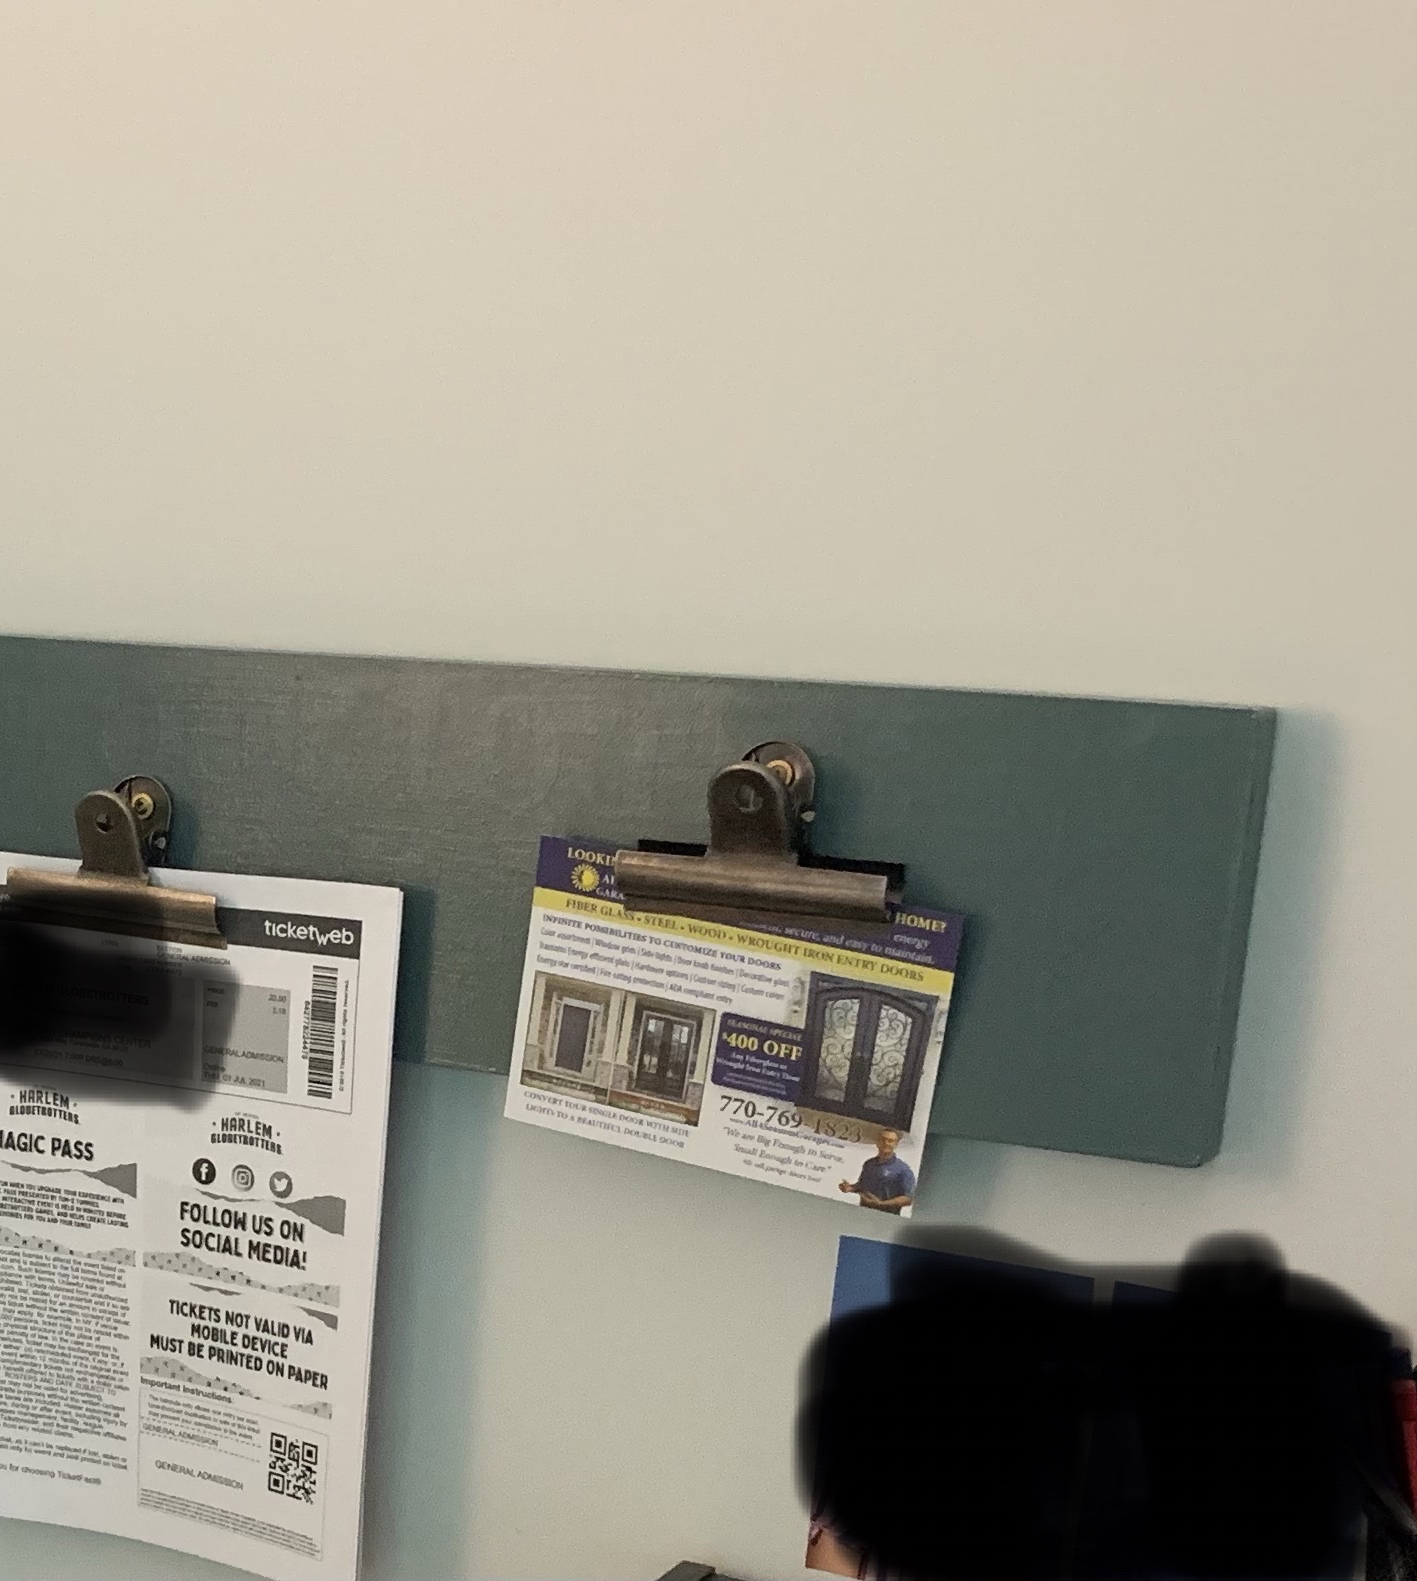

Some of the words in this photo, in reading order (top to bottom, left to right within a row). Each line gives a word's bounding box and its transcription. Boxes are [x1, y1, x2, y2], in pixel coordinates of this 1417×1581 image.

[264, 920, 354, 946] ticketweb
[895, 912, 948, 933] HOME?
[543, 914, 582, 928] INFINITE
[585, 922, 647, 942] POSSIBILITIES
[649, 936, 661, 945] TO
[663, 939, 717, 958] CUSTOMIZE
[720, 951, 745, 963] YOUR
[747, 957, 781, 970] DOORS
[643, 916, 678, 930] STEEL
[688, 924, 726, 939] WOOD
[737, 933, 800, 955] WROUGHT
[803, 947, 835, 964] IRON
[837, 954, 878, 971] ENTRY
[880, 964, 924, 982] DOORS
[893, 932, 931, 949] energy
[192, 954, 230, 965] ADMISSION
[241, 1049, 285, 1064] ADMISSION
[722, 1032, 758, 1051] $400
[763, 1040, 803, 1060] OFF
[249, 1076, 266, 1087] 2021
[20, 1090, 69, 1109] HARLEM
[524, 1091, 562, 1106] CONVERT
[588, 1106, 617, 1119] SINGLE
[619, 1113, 644, 1126] DOOR
[646, 1120, 669, 1133] WITH
[221, 1117, 272, 1139] HARLEM
[557, 1110, 568, 1119] TO
[577, 1116, 621, 1133] BEAUTIFUL
[720, 1095, 862, 1142] 770-769-1823
[51, 1137, 94, 1161] PASS
[180, 1201, 247, 1231] FOLLOW
[252, 1214, 274, 1236] US
[280, 1220, 305, 1242] ON
[180, 1228, 243, 1258] SOCIAL
[248, 1240, 307, 1271] MEDIA!
[169, 1299, 221, 1323] TICKETS
[225, 1311, 251, 1328] NOT
[254, 1316, 290, 1338] VALID
[293, 1326, 313, 1345] VIA
[191, 1322, 238, 1346] MOBILE
[242, 1334, 288, 1359] DEVICE
[150, 1334, 184, 1354] MUST
[188, 1341, 204, 1358] BE
[208, 1346, 263, 1371] PRINTED
[266, 1360, 284, 1377] ON
[288, 1365, 328, 1390] PAPER
[140, 1376, 181, 1392] Important
[143, 1423, 176, 1436] GENERAL
[178, 1431, 218, 1447] ADMISSION
[155, 1459, 195, 1477] GENERAL
[197, 1470, 244, 1491] ADMISSION
